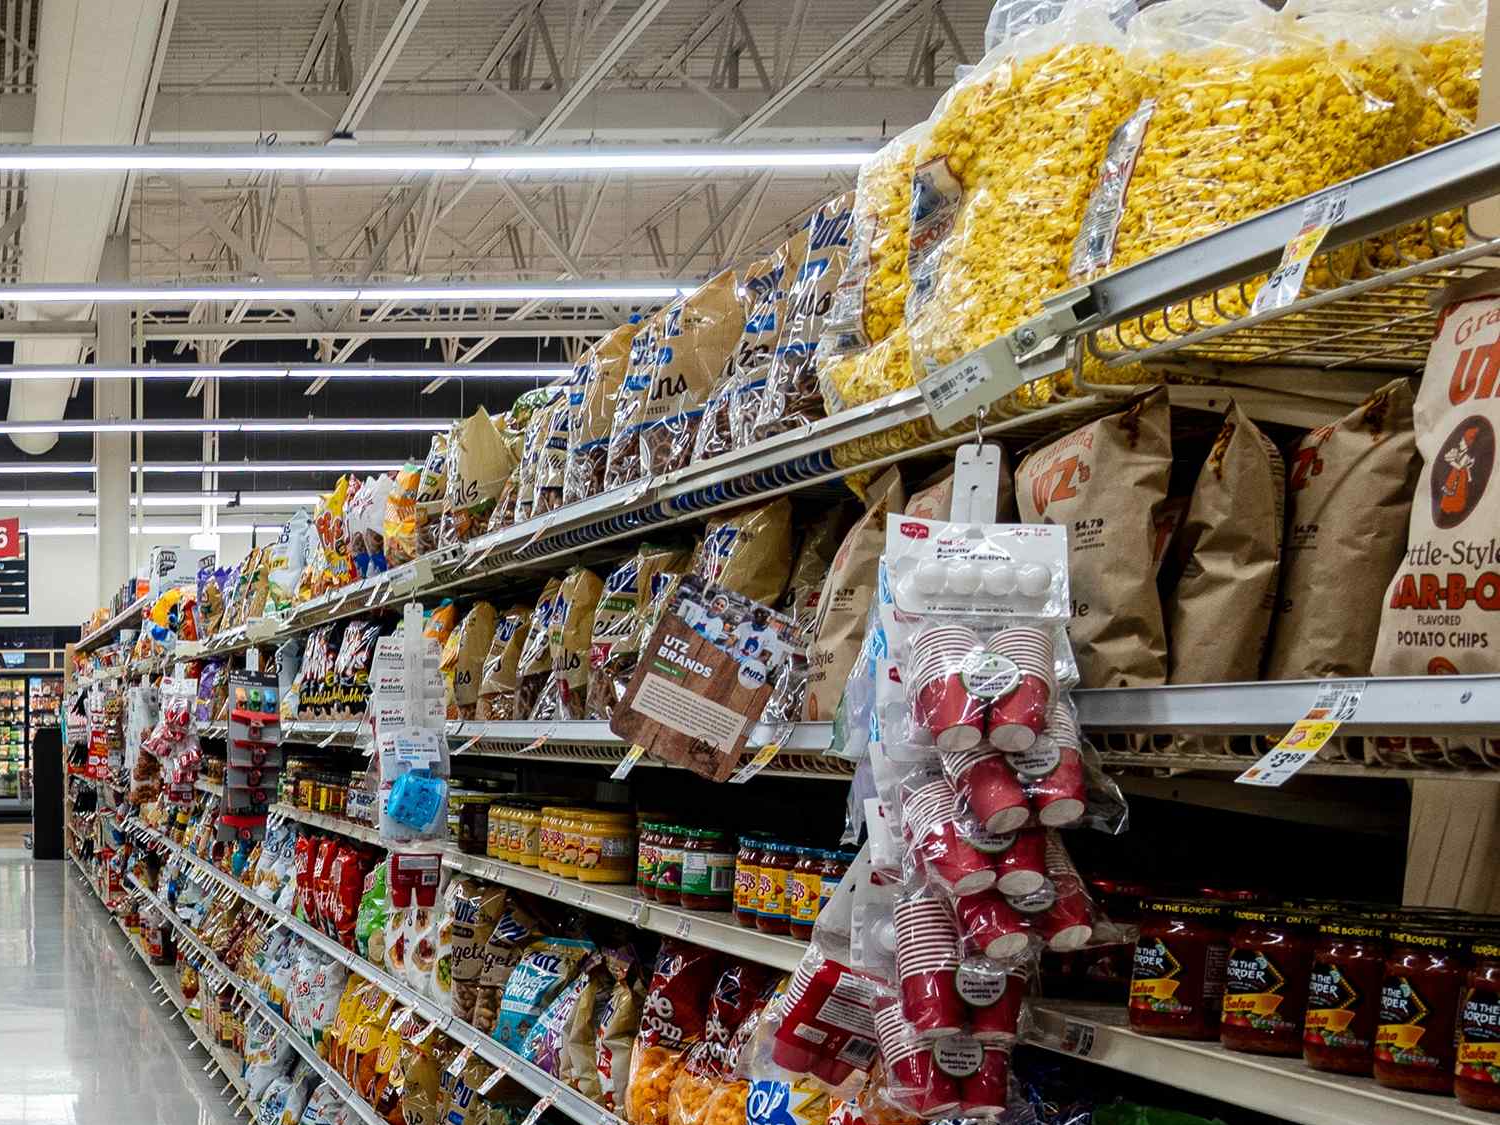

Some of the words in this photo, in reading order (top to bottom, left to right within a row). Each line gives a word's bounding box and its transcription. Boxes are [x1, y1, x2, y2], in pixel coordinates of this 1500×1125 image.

[1074, 518, 1104, 532] $4.79
[1417, 614, 1462, 627] FLAVORED
[663, 634, 690, 654] UTZ
[1398, 631, 1446, 647] POTATO
[1449, 631, 1489, 649] CHIPS
[657, 646, 713, 679] BRANDS
[1225, 996, 1257, 1010] Salsa
